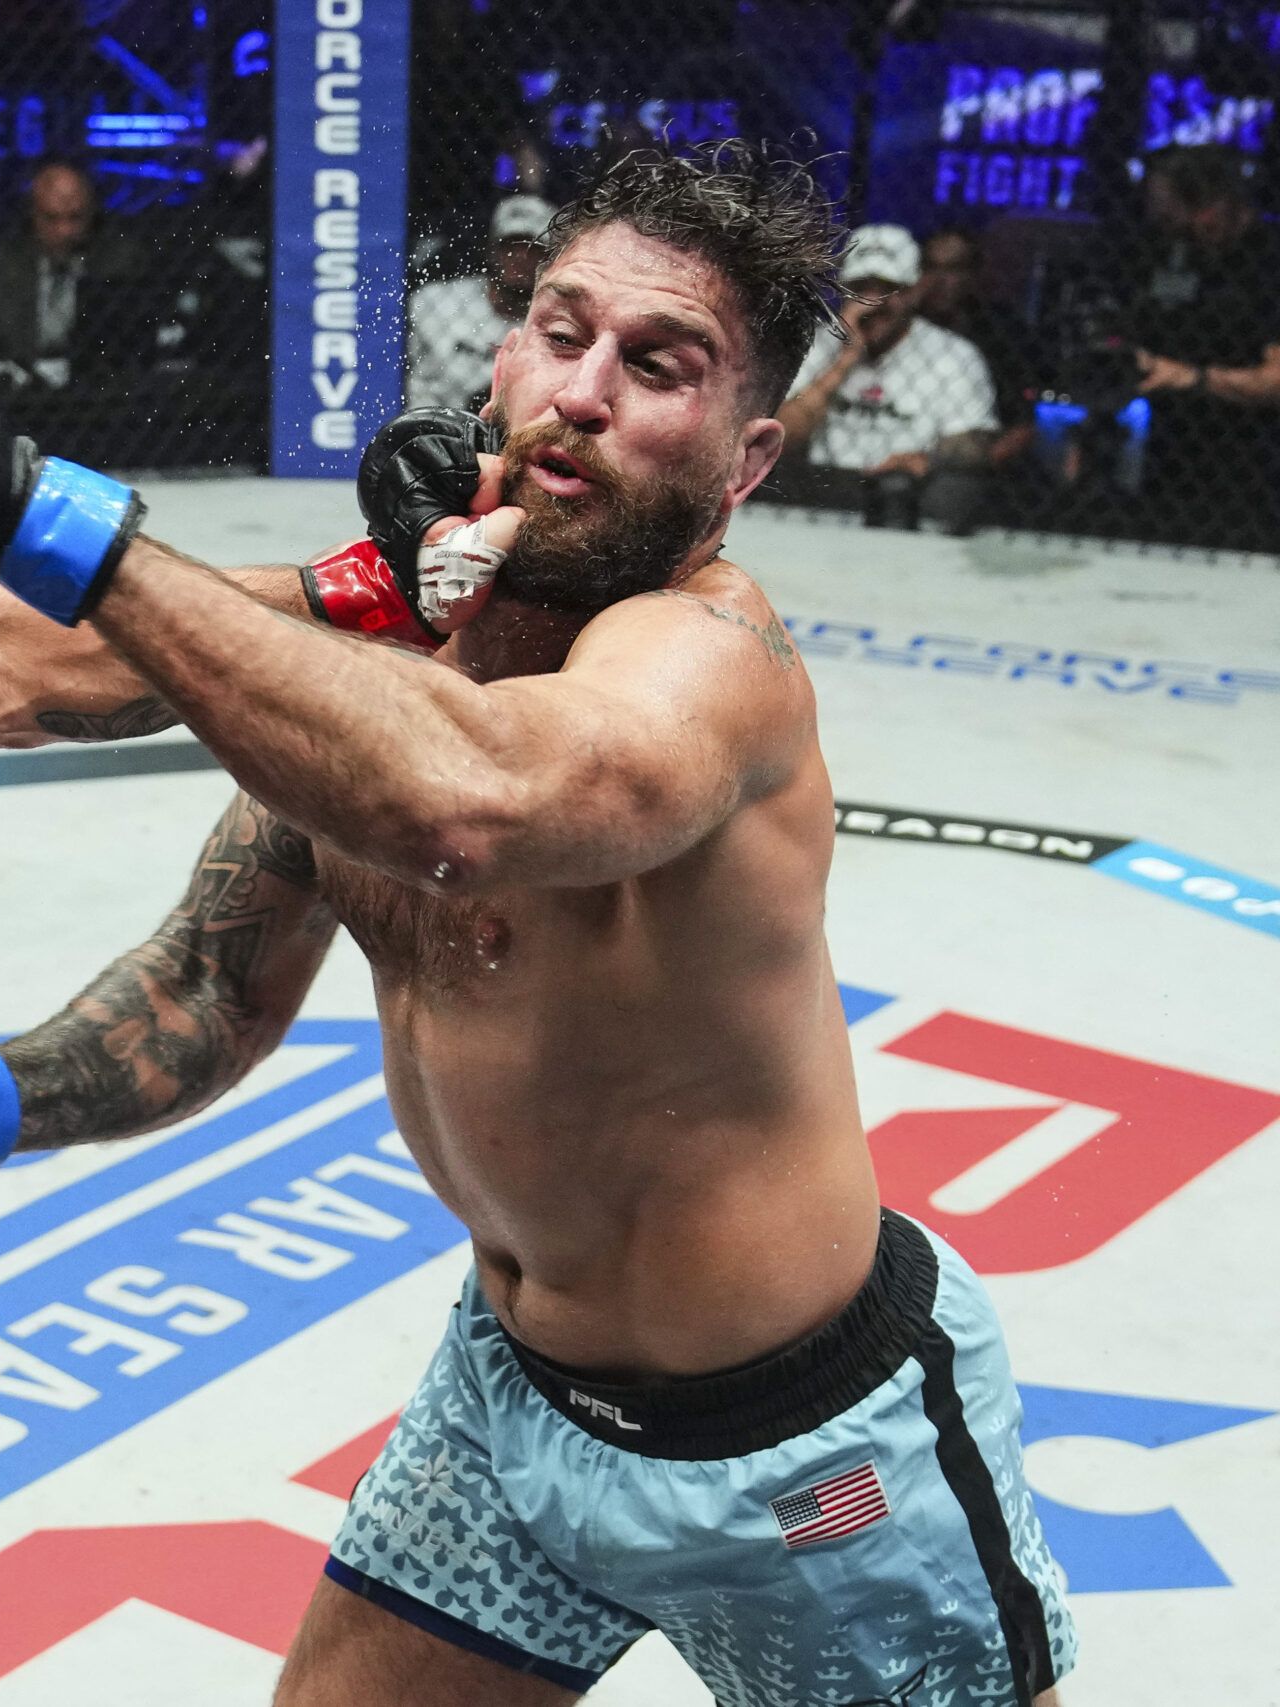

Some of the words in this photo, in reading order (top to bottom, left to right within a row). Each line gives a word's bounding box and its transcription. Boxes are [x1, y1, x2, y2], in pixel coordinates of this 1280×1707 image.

[314, 0, 363, 155] ORCE
[312, 168, 360, 450] RESERVE
[834, 808, 1094, 860] EASON
[569, 1388, 643, 1431] PFL
